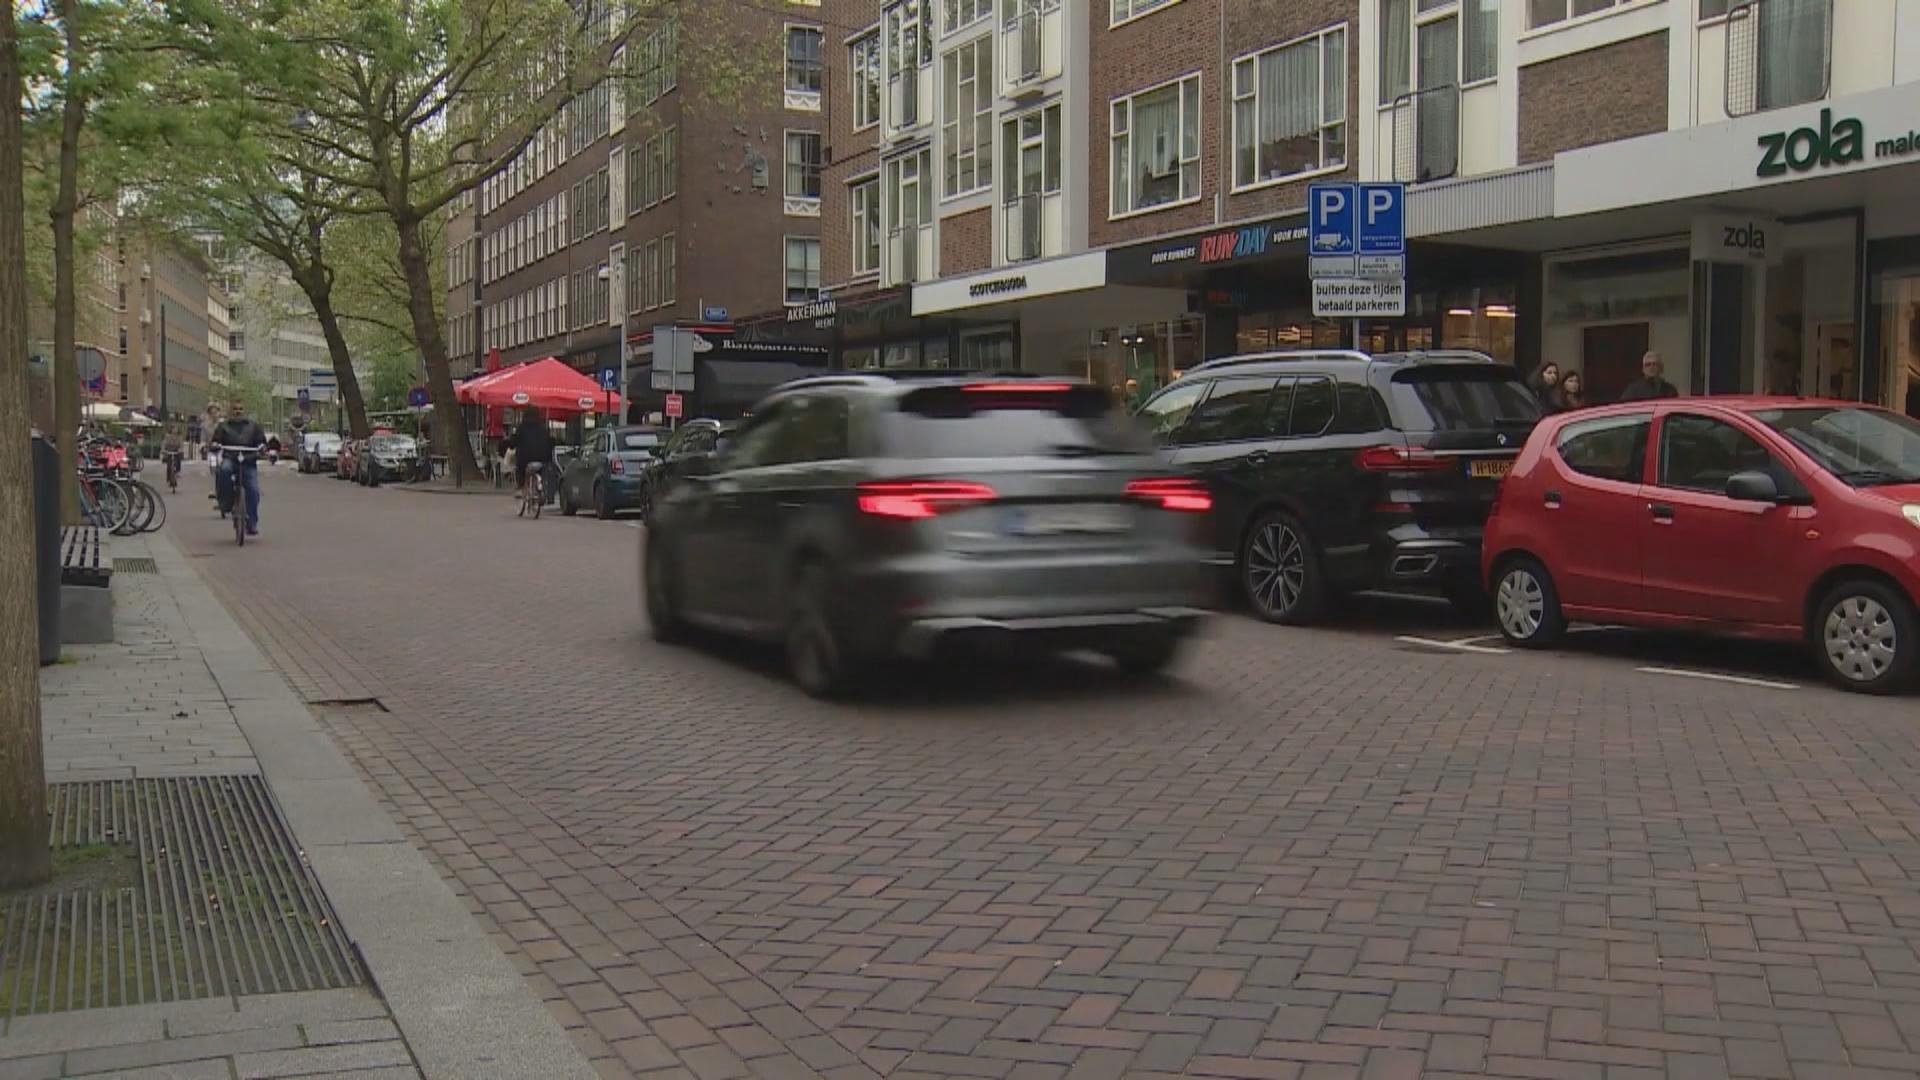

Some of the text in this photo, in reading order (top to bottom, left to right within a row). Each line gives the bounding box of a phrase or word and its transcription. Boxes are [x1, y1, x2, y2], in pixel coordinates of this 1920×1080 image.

[1756, 108, 1863, 177] zola
[1320, 190, 1345, 226] P
[1367, 189, 1393, 225] P
[1723, 222, 1765, 249] zola
[1316, 283, 1402, 298] buiten deze tijden
[787, 300, 836, 323] AKKERMAN
[1318, 300, 1399, 312] betaald parkeren
[605, 369, 614, 381] P
